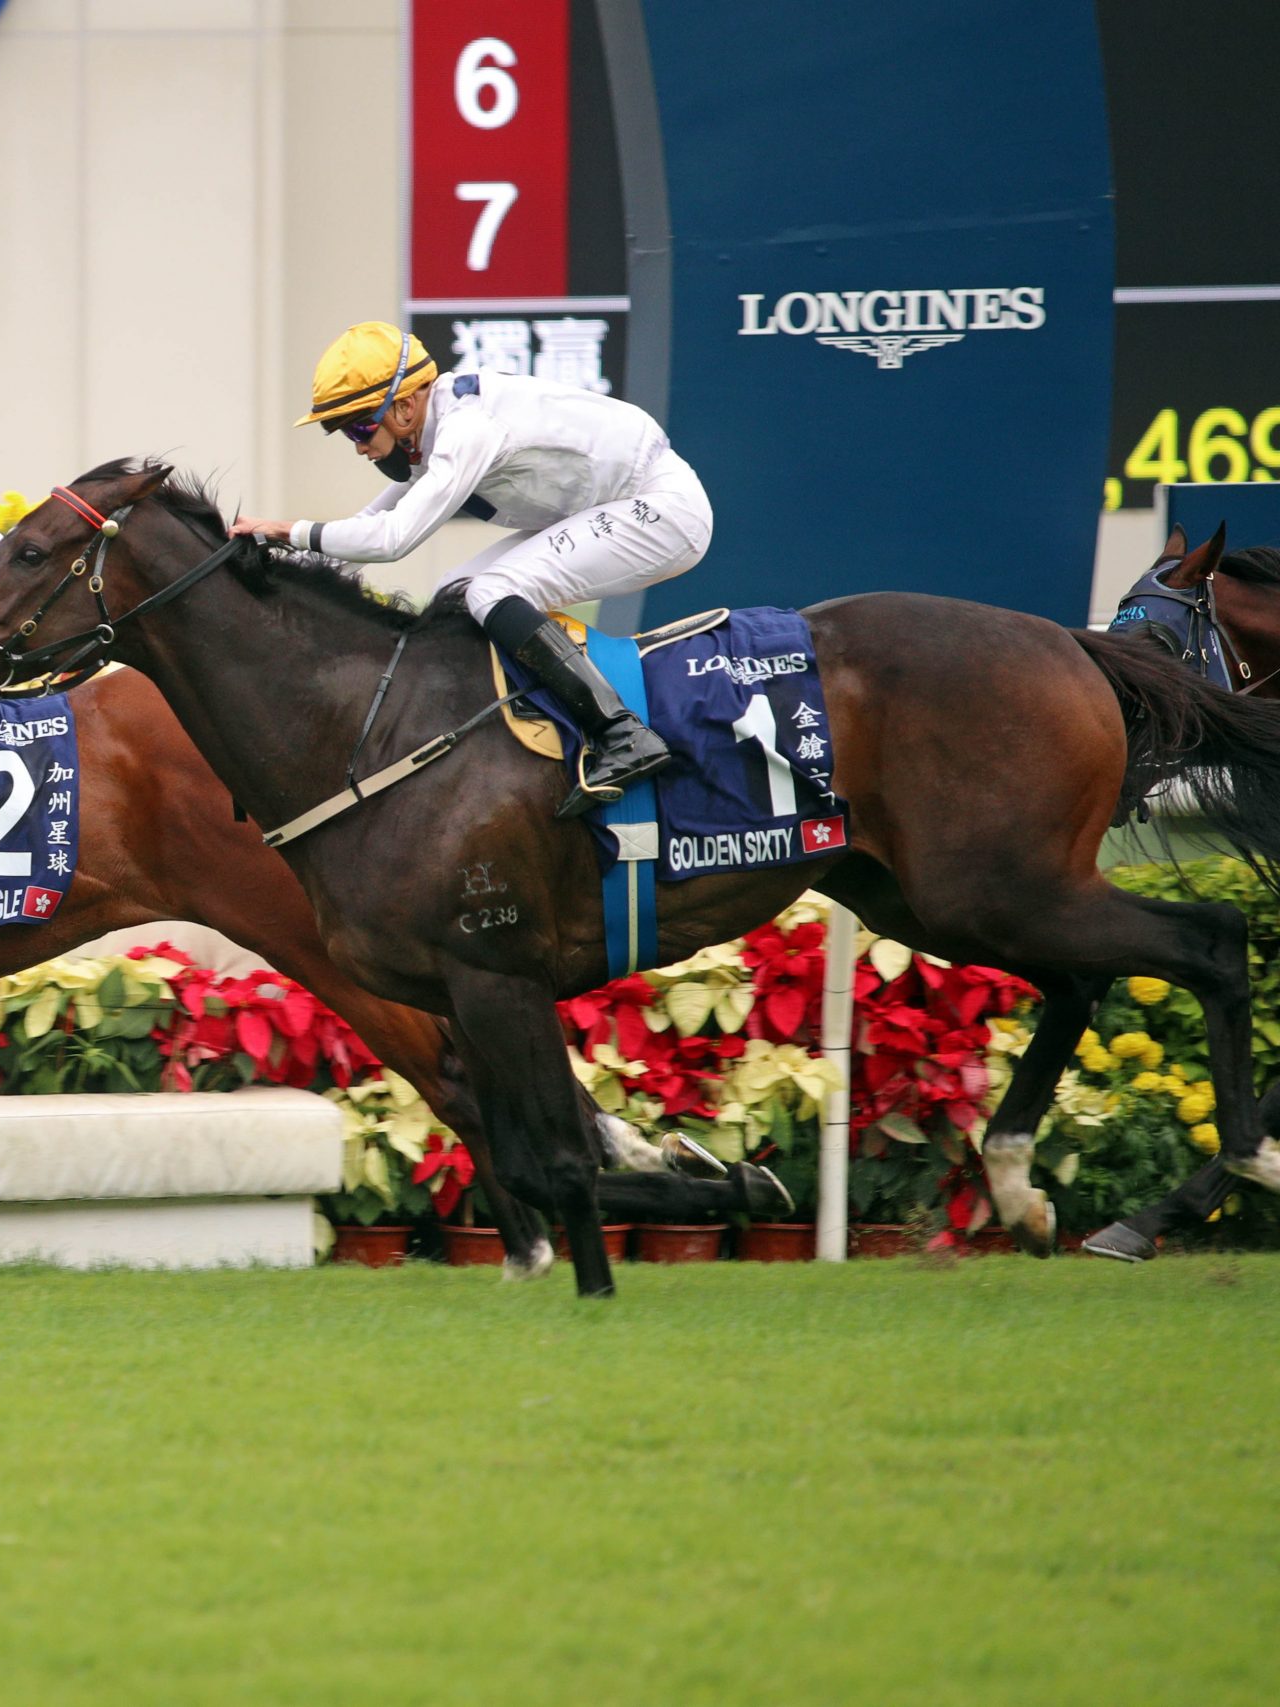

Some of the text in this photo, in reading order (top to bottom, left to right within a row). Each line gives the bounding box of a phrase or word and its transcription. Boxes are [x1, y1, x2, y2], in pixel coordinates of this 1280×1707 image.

[454, 37, 519, 130] 6
[454, 181, 519, 271] 7
[737, 287, 1046, 335] LONGINES
[732, 694, 797, 817] 1
[46, 761, 75, 877] 加州星球
[670, 827, 794, 872] GOLDEN SIXTY
